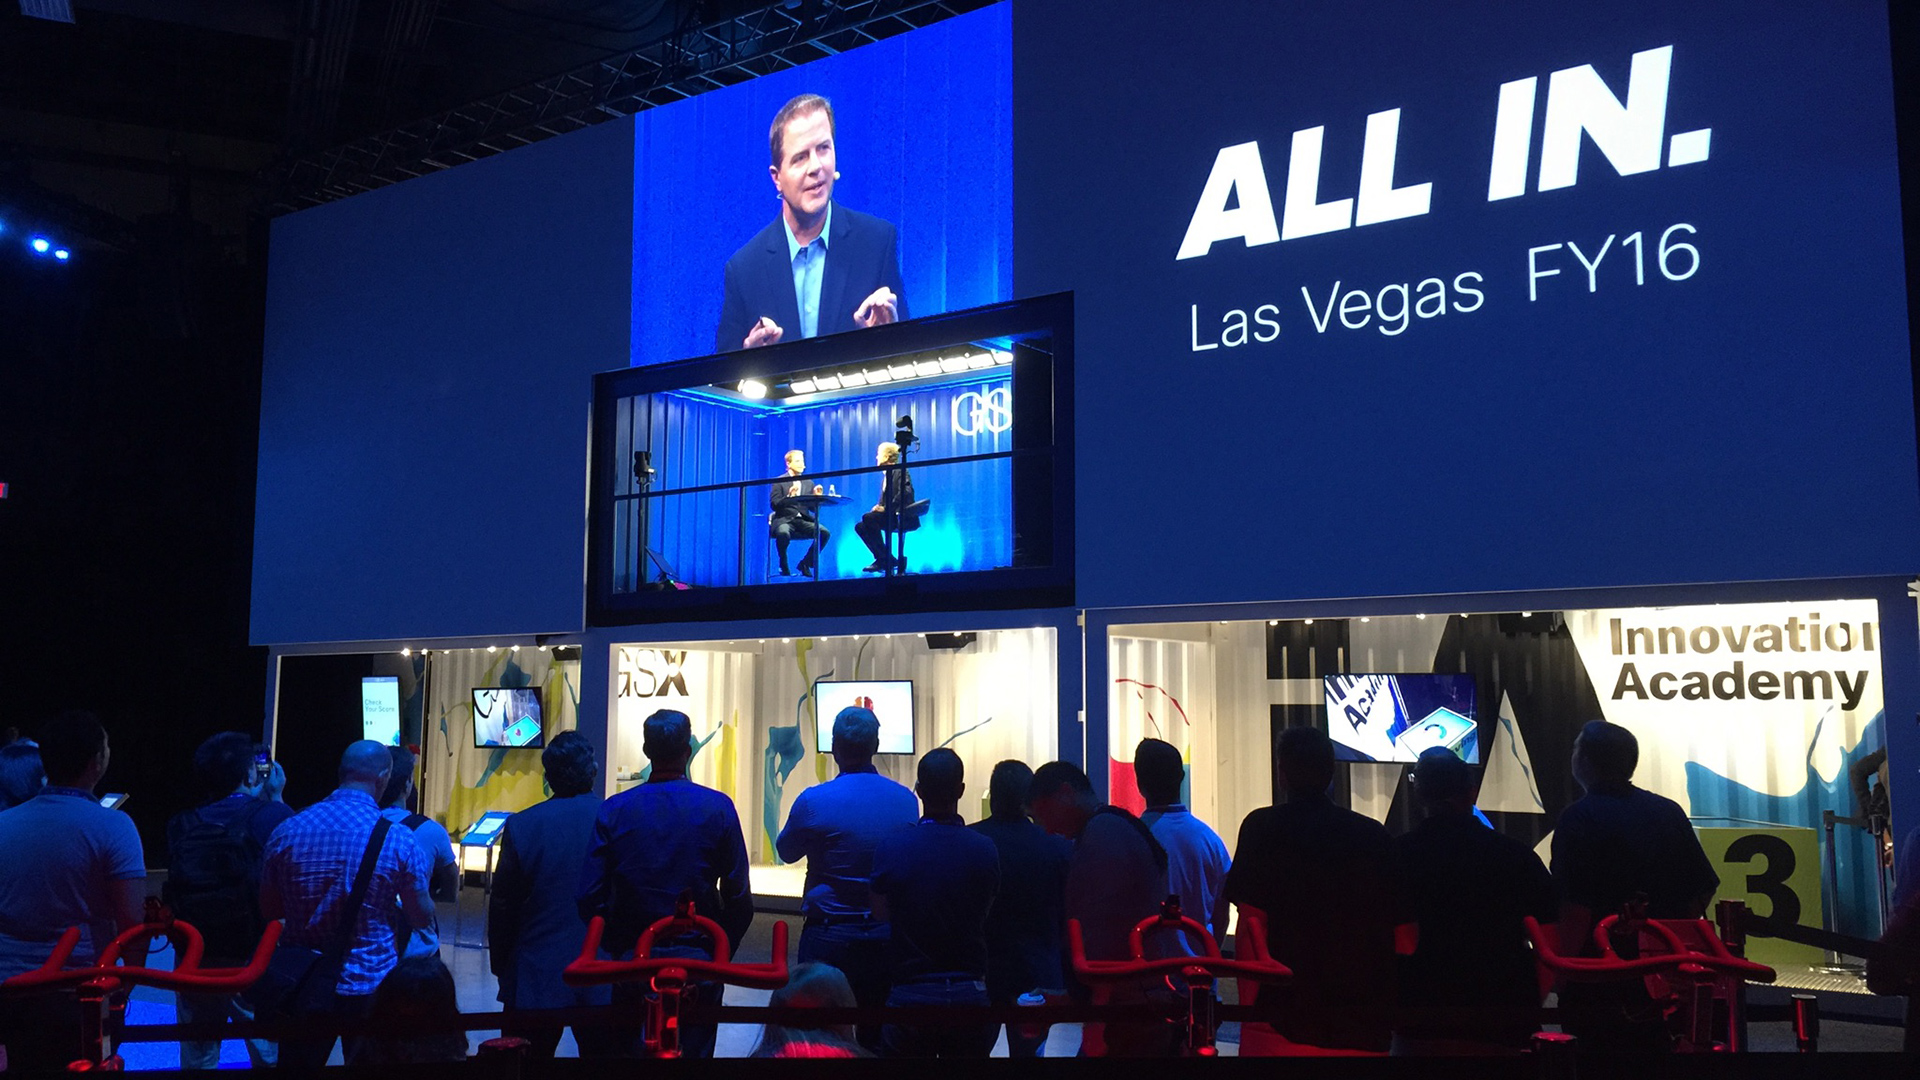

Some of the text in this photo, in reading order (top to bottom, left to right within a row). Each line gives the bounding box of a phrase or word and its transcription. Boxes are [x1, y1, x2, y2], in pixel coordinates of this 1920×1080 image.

[1176, 45, 1712, 261] ALL IN.
[1191, 223, 1700, 352] Las Vegas FY16
[365, 698, 382, 706] Check
[365, 705, 395, 713] Your Score
[1611, 660, 1869, 712] Academy
[1723, 834, 1801, 938] 3
